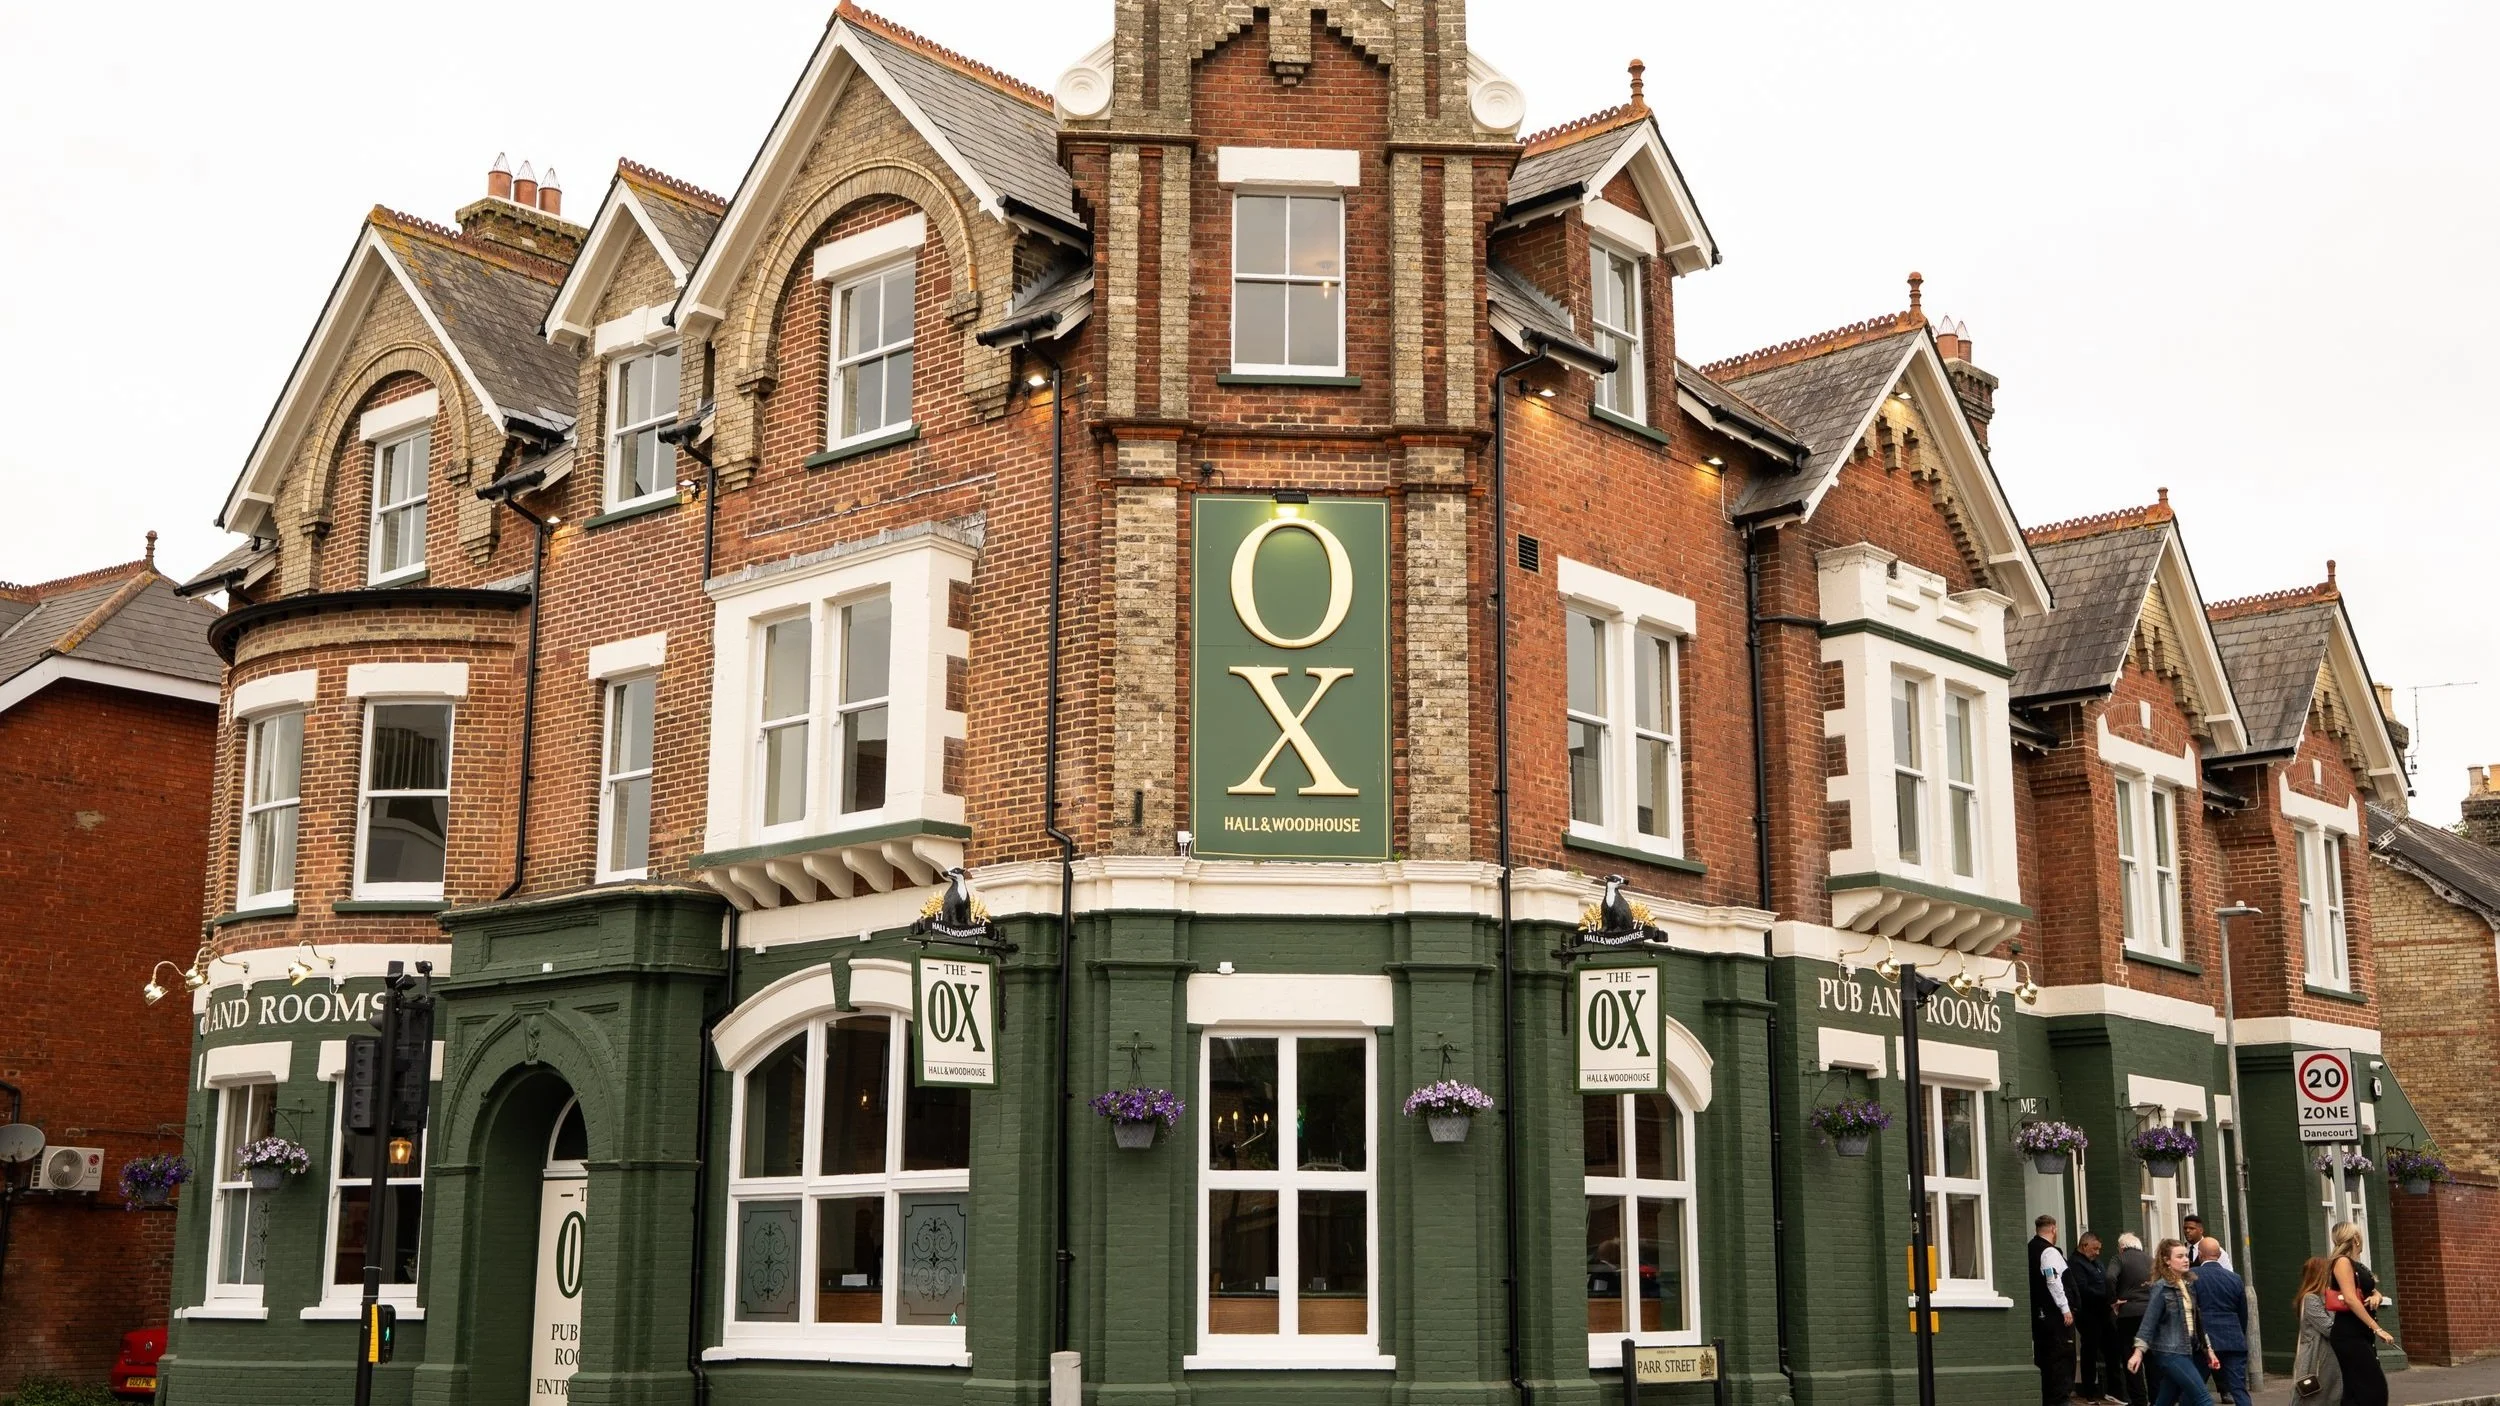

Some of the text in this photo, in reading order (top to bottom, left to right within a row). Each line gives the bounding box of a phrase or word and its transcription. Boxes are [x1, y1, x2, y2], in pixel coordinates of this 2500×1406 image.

[1224, 816, 1361, 833] HALL&WOODHOUSE
[931, 922, 987, 937] HALL&WOODHOUSE
[1583, 930, 1645, 946] HALL&WOODHOUSE
[943, 964, 967, 976] THE
[1606, 972, 1632, 983] THE
[1818, 977, 2002, 1034] PUB AN ROOMS
[210, 998, 250, 1032] AND
[928, 980, 986, 1053] OX
[1588, 989, 1651, 1058] OX
[928, 1066, 987, 1077] HALL&WOODHOUSE
[1586, 1073, 1651, 1083] HALL&WOODHOUSE
[2306, 1068, 2341, 1088] 20
[2303, 1106, 2349, 1119] ZONE
[2304, 1129, 2354, 1138] Danecourt
[556, 1211, 586, 1299] O
[551, 1323, 578, 1341] PUB
[1637, 1359, 1697, 1374] PARR STREET
